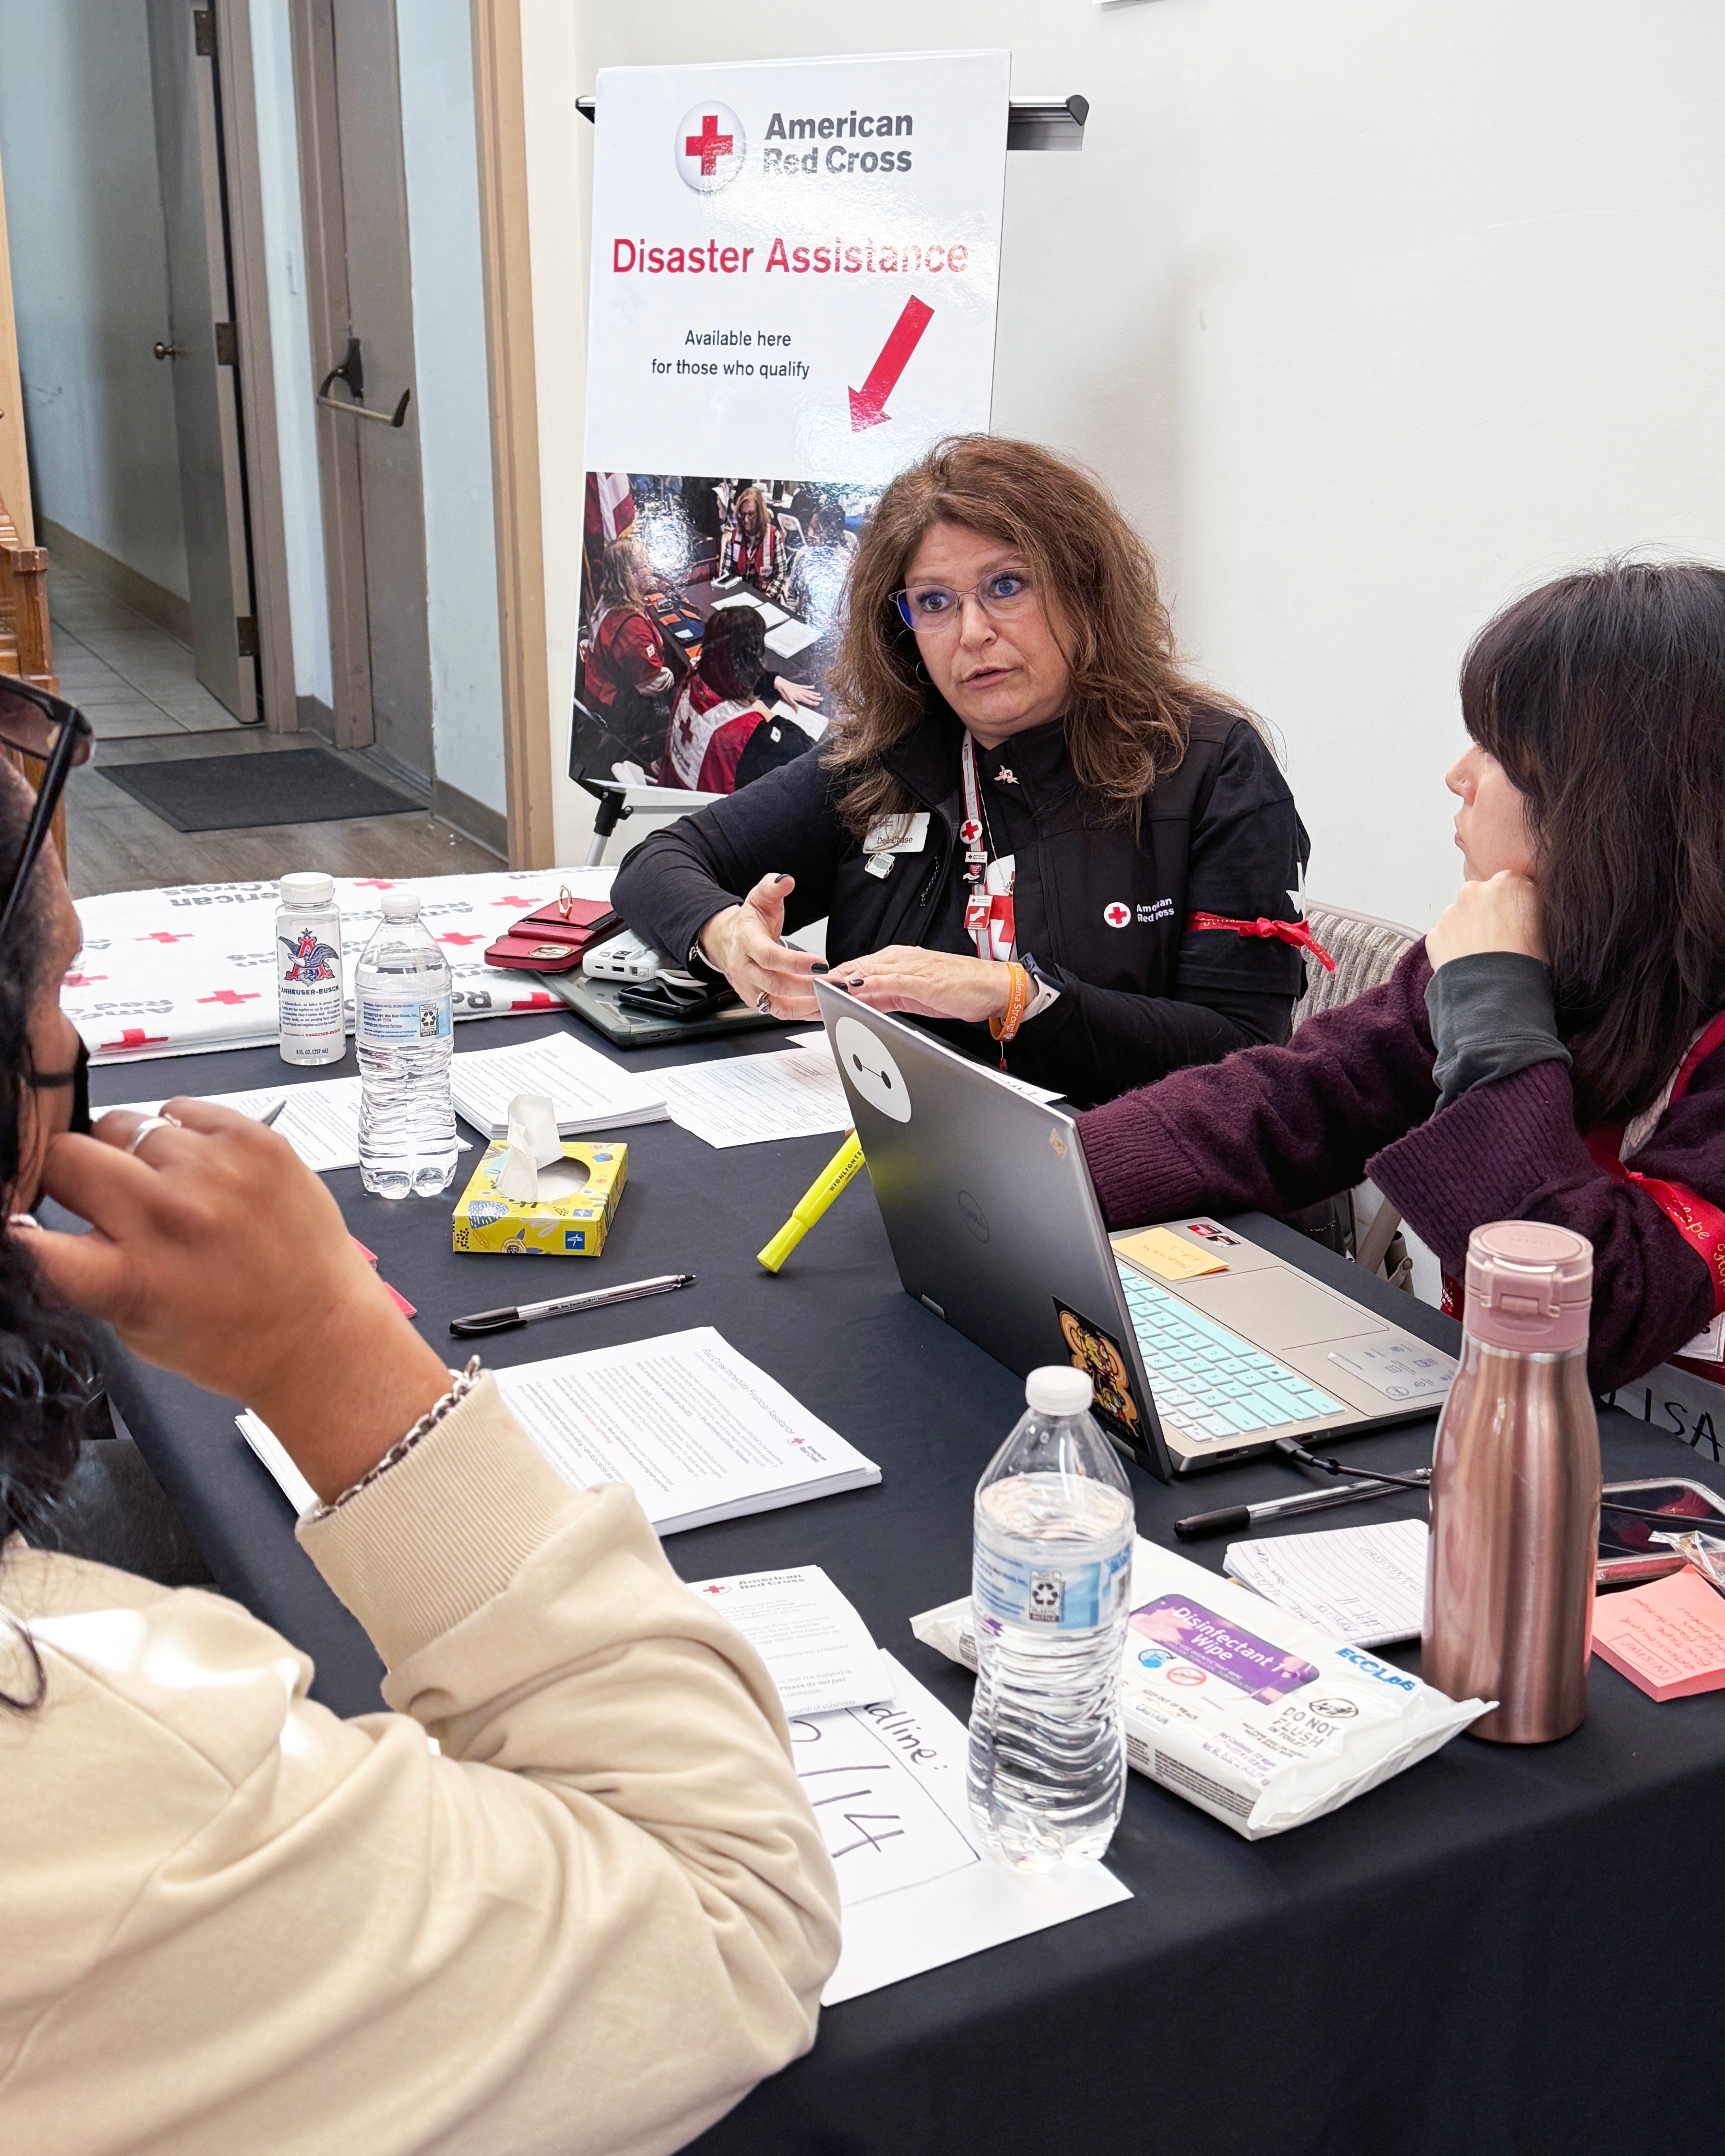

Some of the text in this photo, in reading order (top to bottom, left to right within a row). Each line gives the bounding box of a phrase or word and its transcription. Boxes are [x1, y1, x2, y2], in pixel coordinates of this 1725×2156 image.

[764, 111, 913, 141] American
[764, 145, 913, 176] Red Cross
[613, 237, 969, 274] Disaster Assistance
[685, 330, 792, 347] Available here
[651, 359, 810, 380] for those who qualify
[169, 891, 281, 907] erican
[1138, 914, 1154, 922] Red
[828, 1148, 862, 1191] HIGHLIGHTE
[739, 1575, 802, 1585] American
[768, 1578, 805, 1586] Cross
[1173, 1607, 1274, 1667] Disinfectant
[1272, 1663, 1286, 1672] 1
[1191, 1634, 1233, 1660] Wipe
[1335, 1648, 1415, 1691] ECOLAB
[1272, 1717, 1325, 1747] FLUSH
[1282, 1707, 1341, 1737] DO NOT
[1278, 1732, 1308, 1747] TOILET
